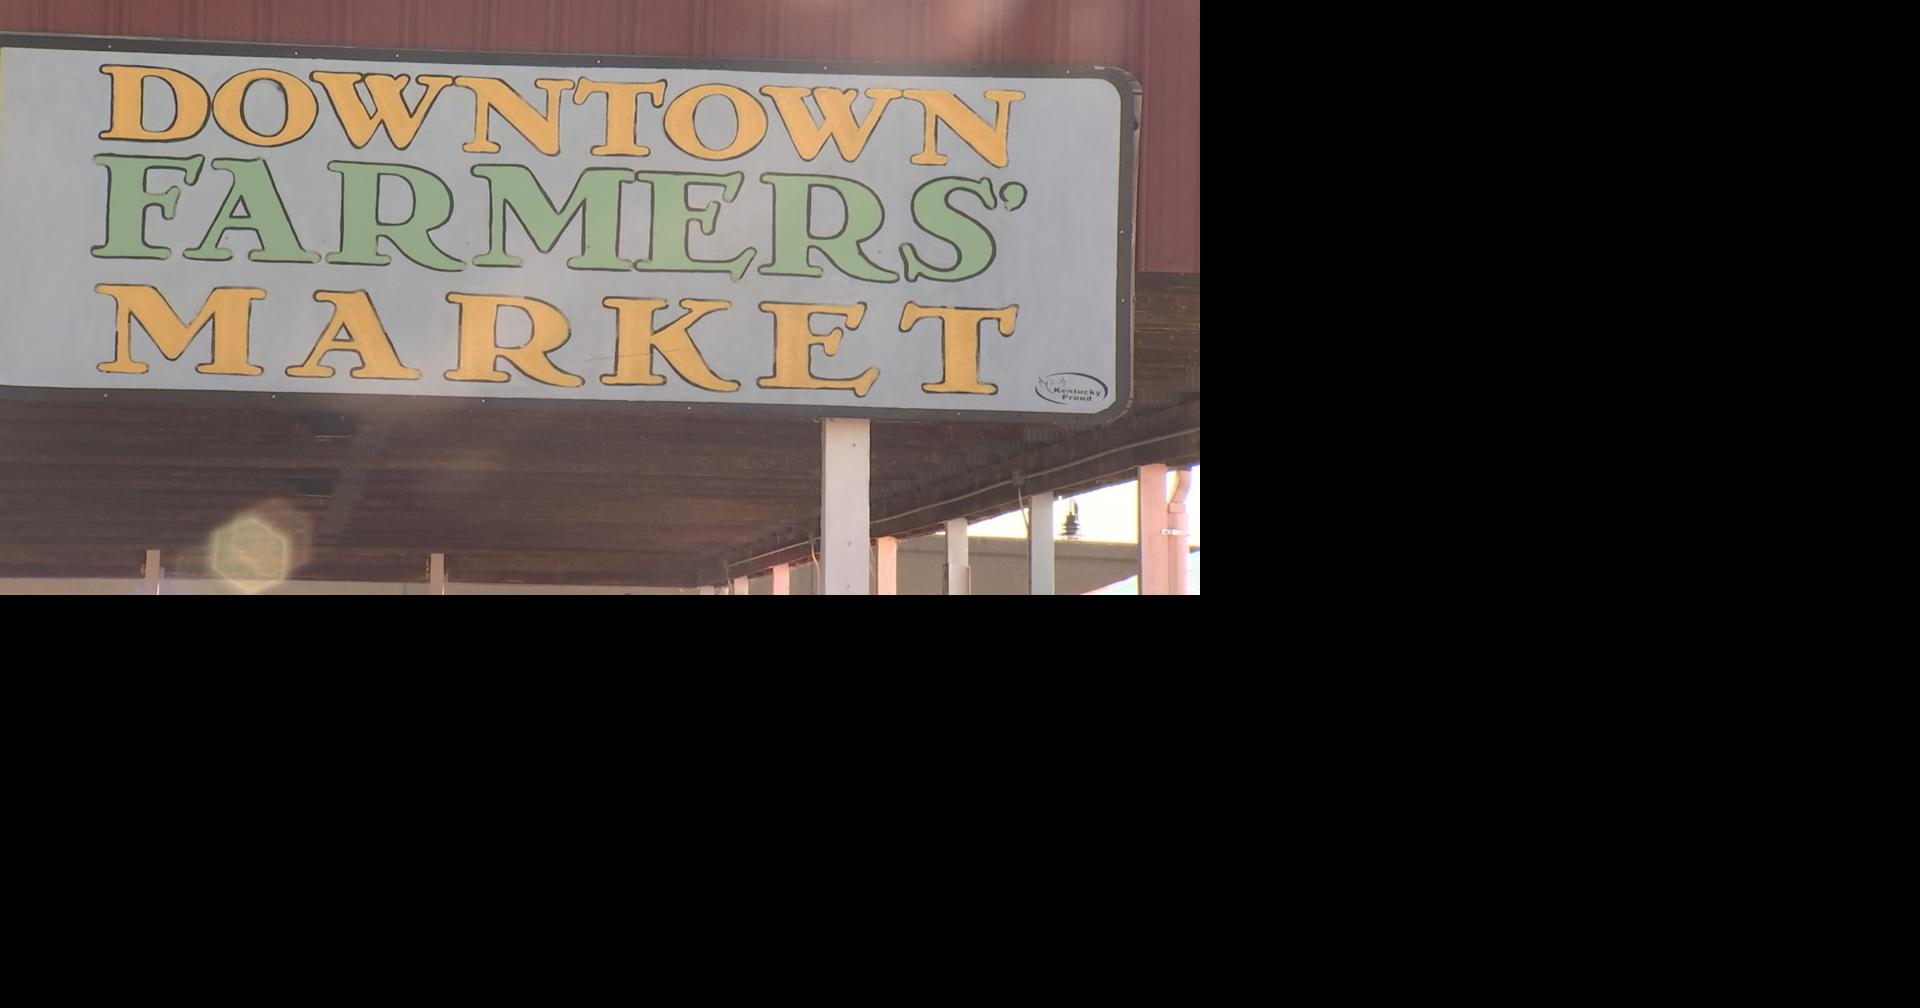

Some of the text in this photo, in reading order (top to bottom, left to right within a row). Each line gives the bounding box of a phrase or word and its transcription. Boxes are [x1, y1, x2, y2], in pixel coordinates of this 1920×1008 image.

[99, 64, 1025, 167] DOWNTOWN
[91, 153, 1028, 283] FARMERS'
[94, 283, 1018, 397] MARKET
[1054, 387, 1101, 397] Kentucky
